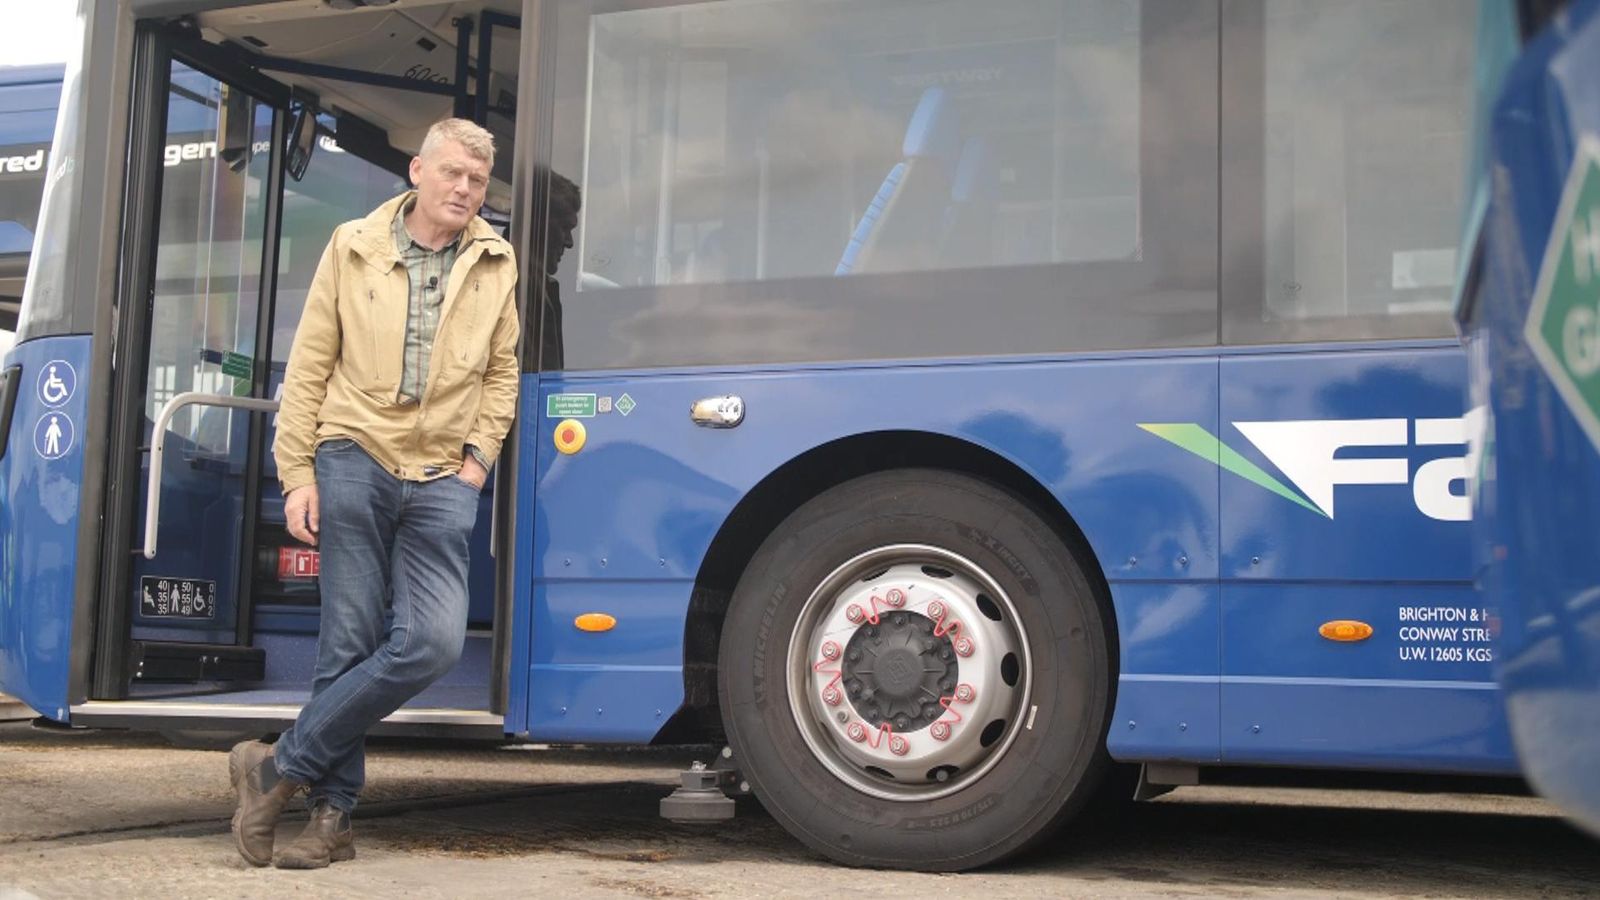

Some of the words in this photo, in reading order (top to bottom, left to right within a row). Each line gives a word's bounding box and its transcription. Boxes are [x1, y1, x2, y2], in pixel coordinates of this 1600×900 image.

[164, 141, 217, 167] gen
[158, 580, 167, 590] 40
[181, 582, 191, 593] 50
[157, 592, 167, 603] 35
[181, 593, 191, 604] 55
[157, 603, 167, 615] 35
[181, 605, 191, 616] 49
[1399, 607, 1467, 621] BRIGHTON
[1469, 608, 1479, 621] &
[753, 582, 788, 678] MICHELIN
[1399, 627, 1459, 641] CONWAY
[1399, 647, 1427, 661] U.W.
[1430, 647, 1463, 661] 12605
